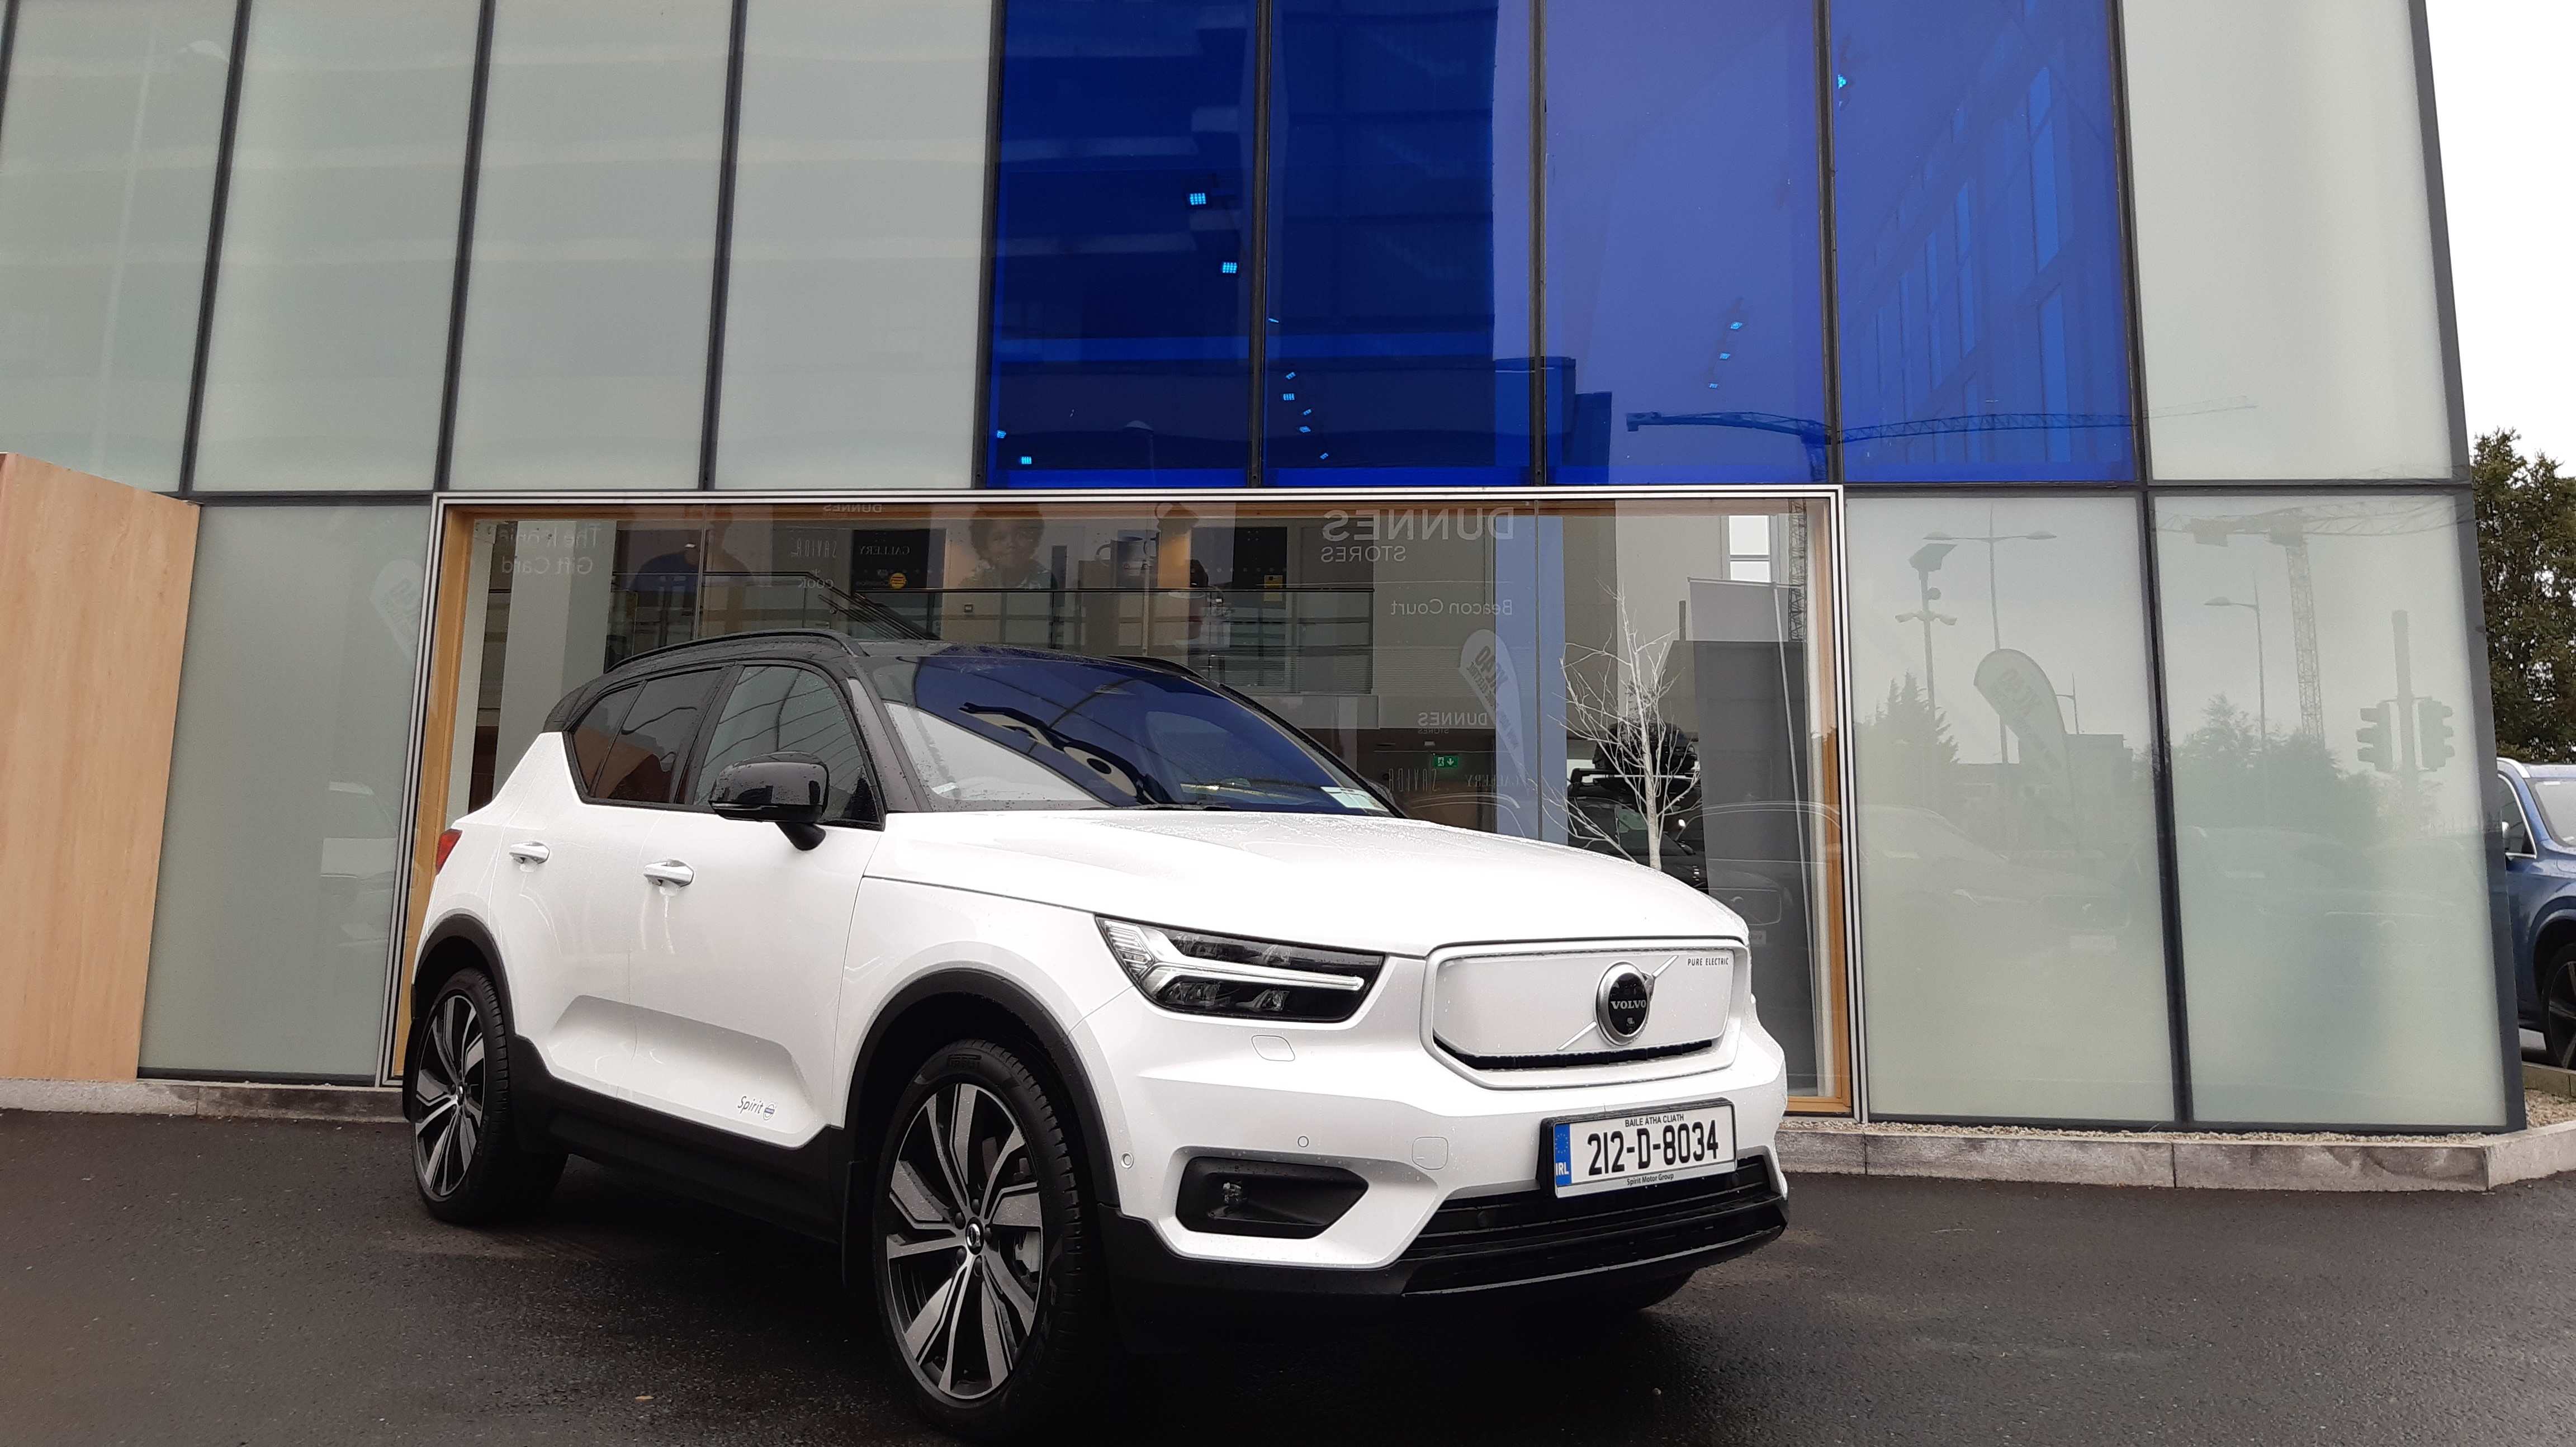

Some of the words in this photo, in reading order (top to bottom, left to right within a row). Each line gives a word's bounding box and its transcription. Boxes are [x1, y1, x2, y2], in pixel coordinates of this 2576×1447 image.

[1705, 957, 1729, 966] ELECTRIC
[1610, 1000, 1647, 1010] VOLVO
[737, 1095, 764, 1114] Spirit
[1625, 1118, 1644, 1128] BAILE
[1645, 1115, 1662, 1125] ÁTHA
[1663, 1113, 1684, 1123] CLIATH
[1587, 1119, 1719, 1176] 212-D-8034
[1555, 1161, 1570, 1176] IRL
[1627, 1177, 1641, 1186] Spirit
[1642, 1175, 1658, 1183] Motor
[1658, 1173, 1674, 1182] Group
